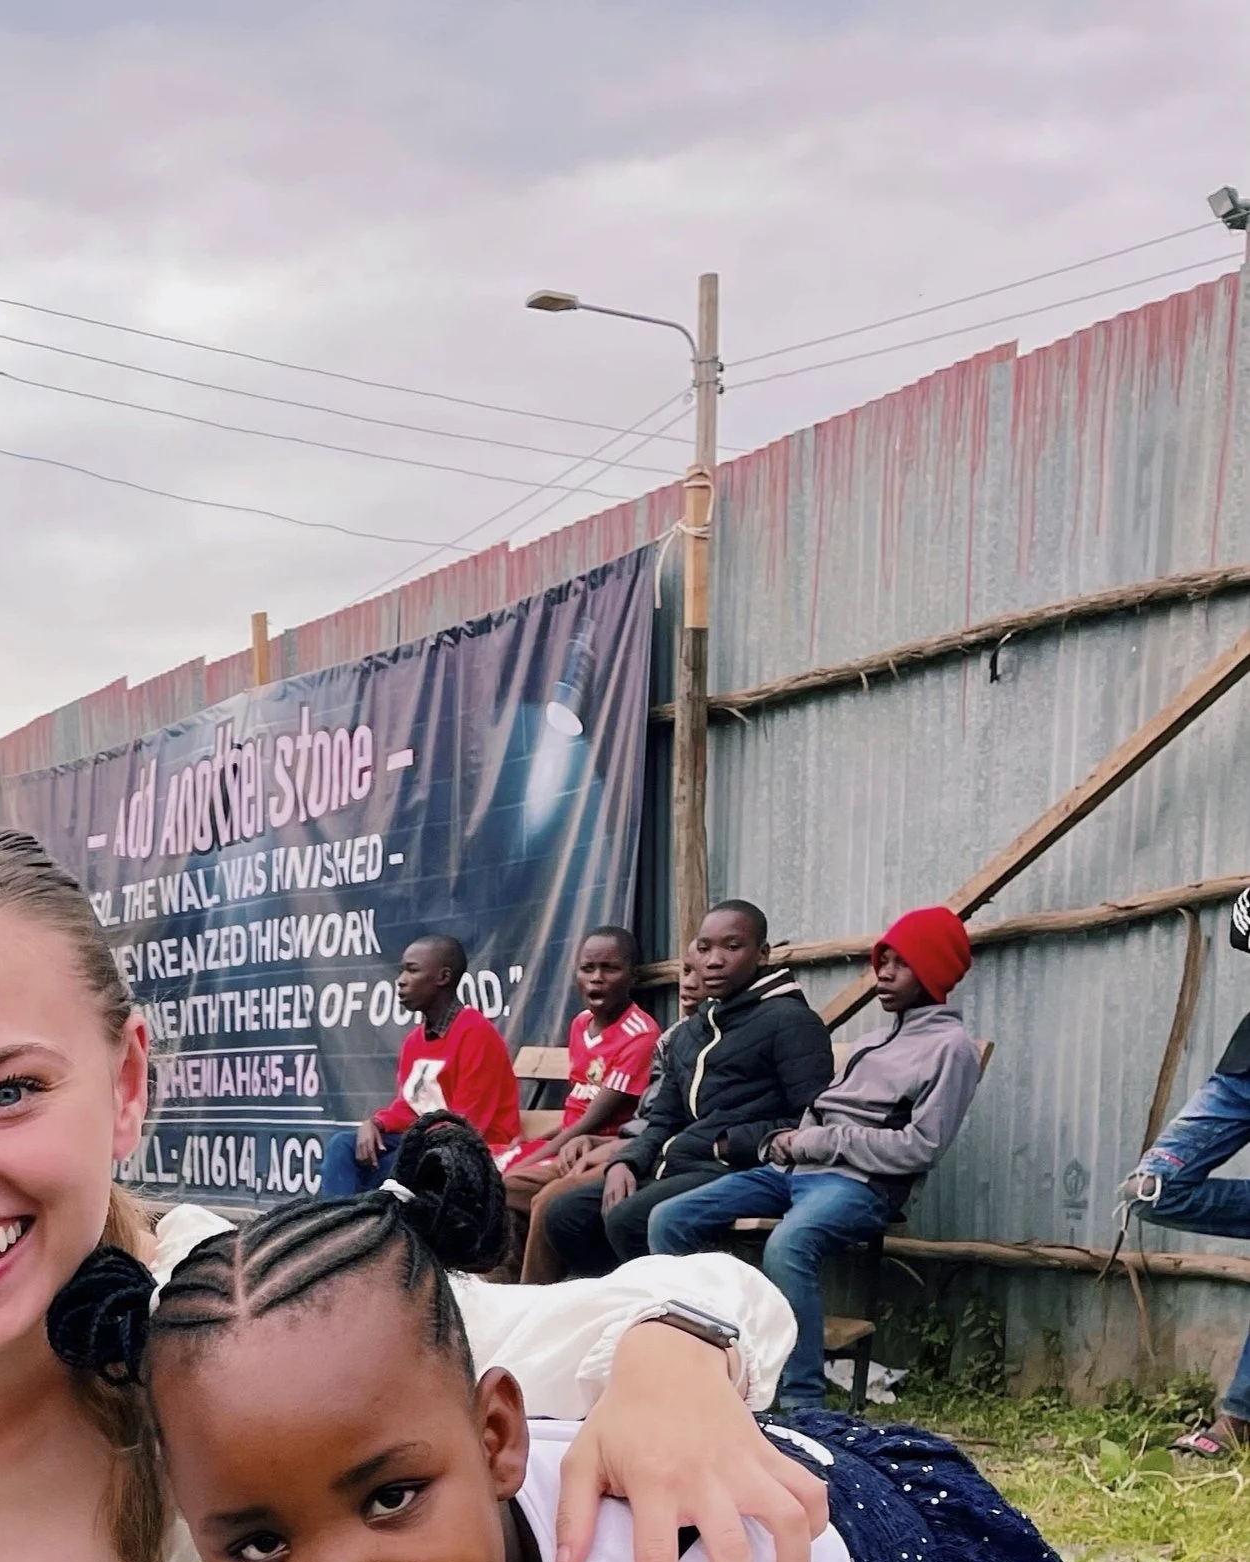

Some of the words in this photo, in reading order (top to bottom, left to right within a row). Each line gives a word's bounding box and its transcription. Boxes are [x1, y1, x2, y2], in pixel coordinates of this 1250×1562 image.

[270, 706, 373, 828] stone
[122, 879, 157, 922] THE
[291, 908, 382, 959] WORK
[318, 981, 367, 1027] OF
[368, 979, 423, 1026] OU
[267, 1137, 322, 1196] ACC
